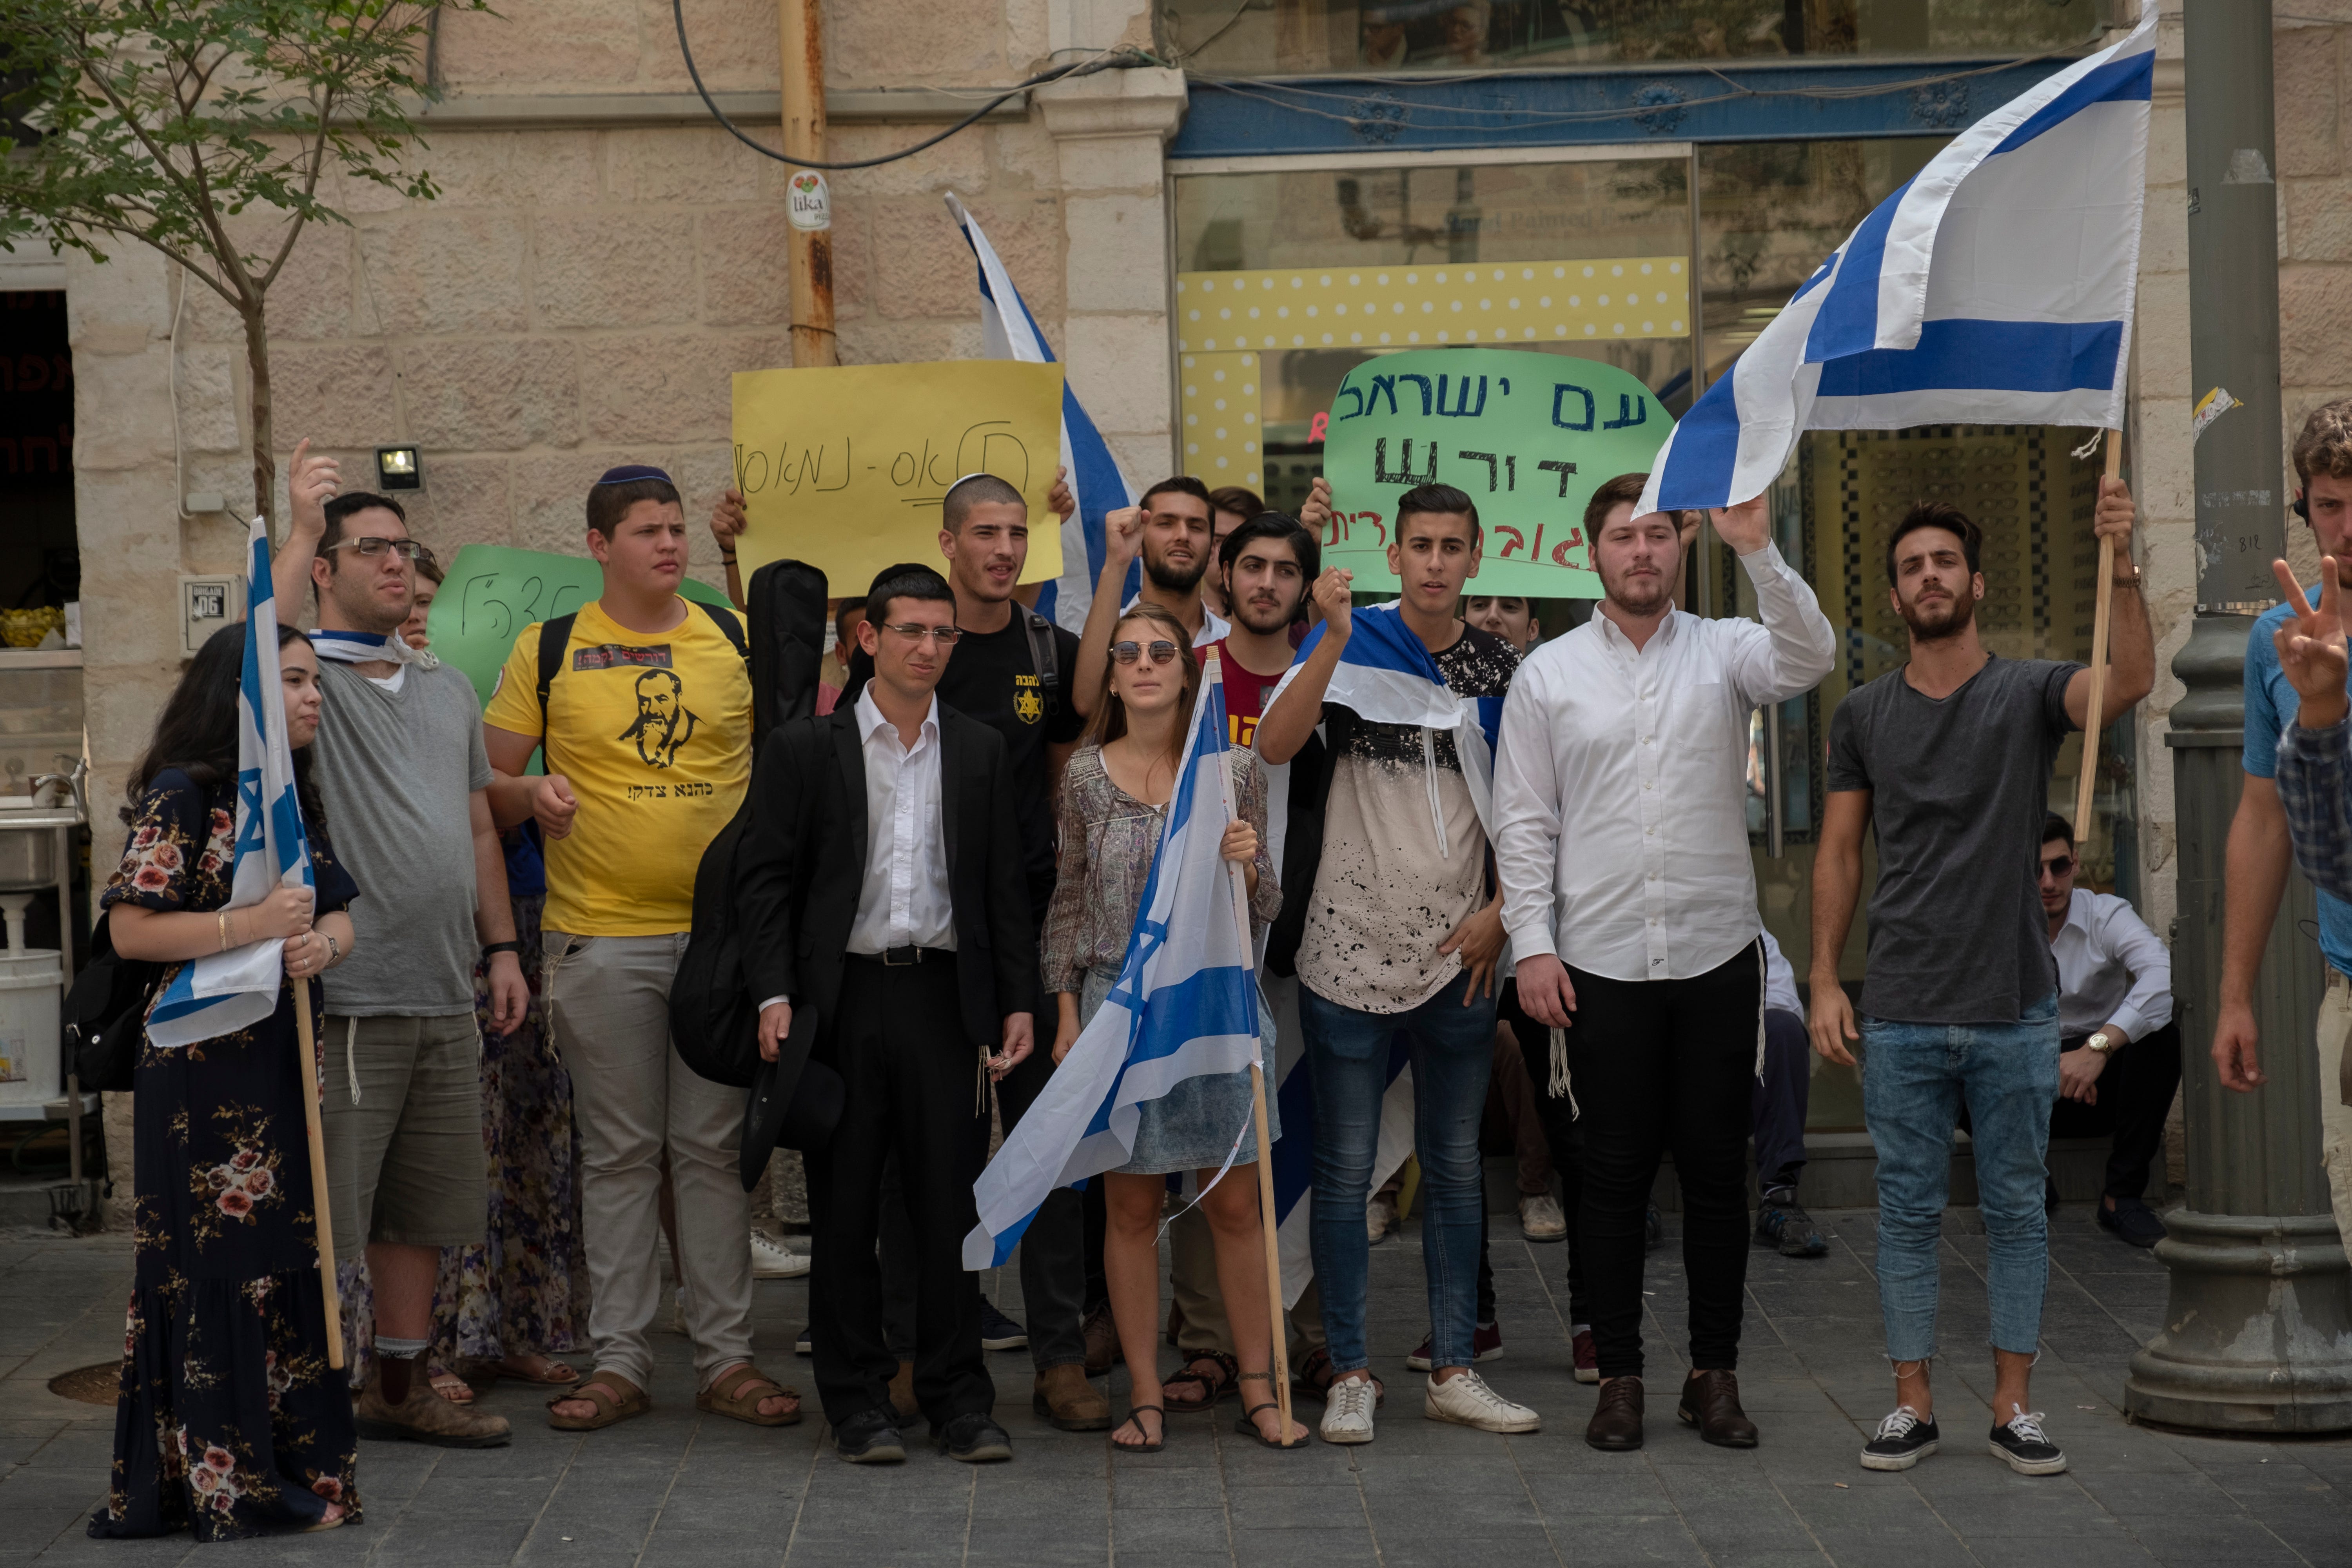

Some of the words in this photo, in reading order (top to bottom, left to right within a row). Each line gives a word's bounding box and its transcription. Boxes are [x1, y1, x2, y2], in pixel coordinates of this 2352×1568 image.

[793, 195, 822, 212] lika
[1337, 372, 1511, 421] ישראל
[1552, 382, 1647, 432] עם
[1375, 437, 1578, 498] דורש
[193, 586, 223, 596] BRIGADE
[198, 596, 218, 613] 06
[578, 651, 614, 667] נקמה!
[622, 650, 667, 663] דורשים
[1015, 673, 1040, 687] להבה
[628, 785, 667, 801] צדק!
[674, 782, 713, 798] כהנא
